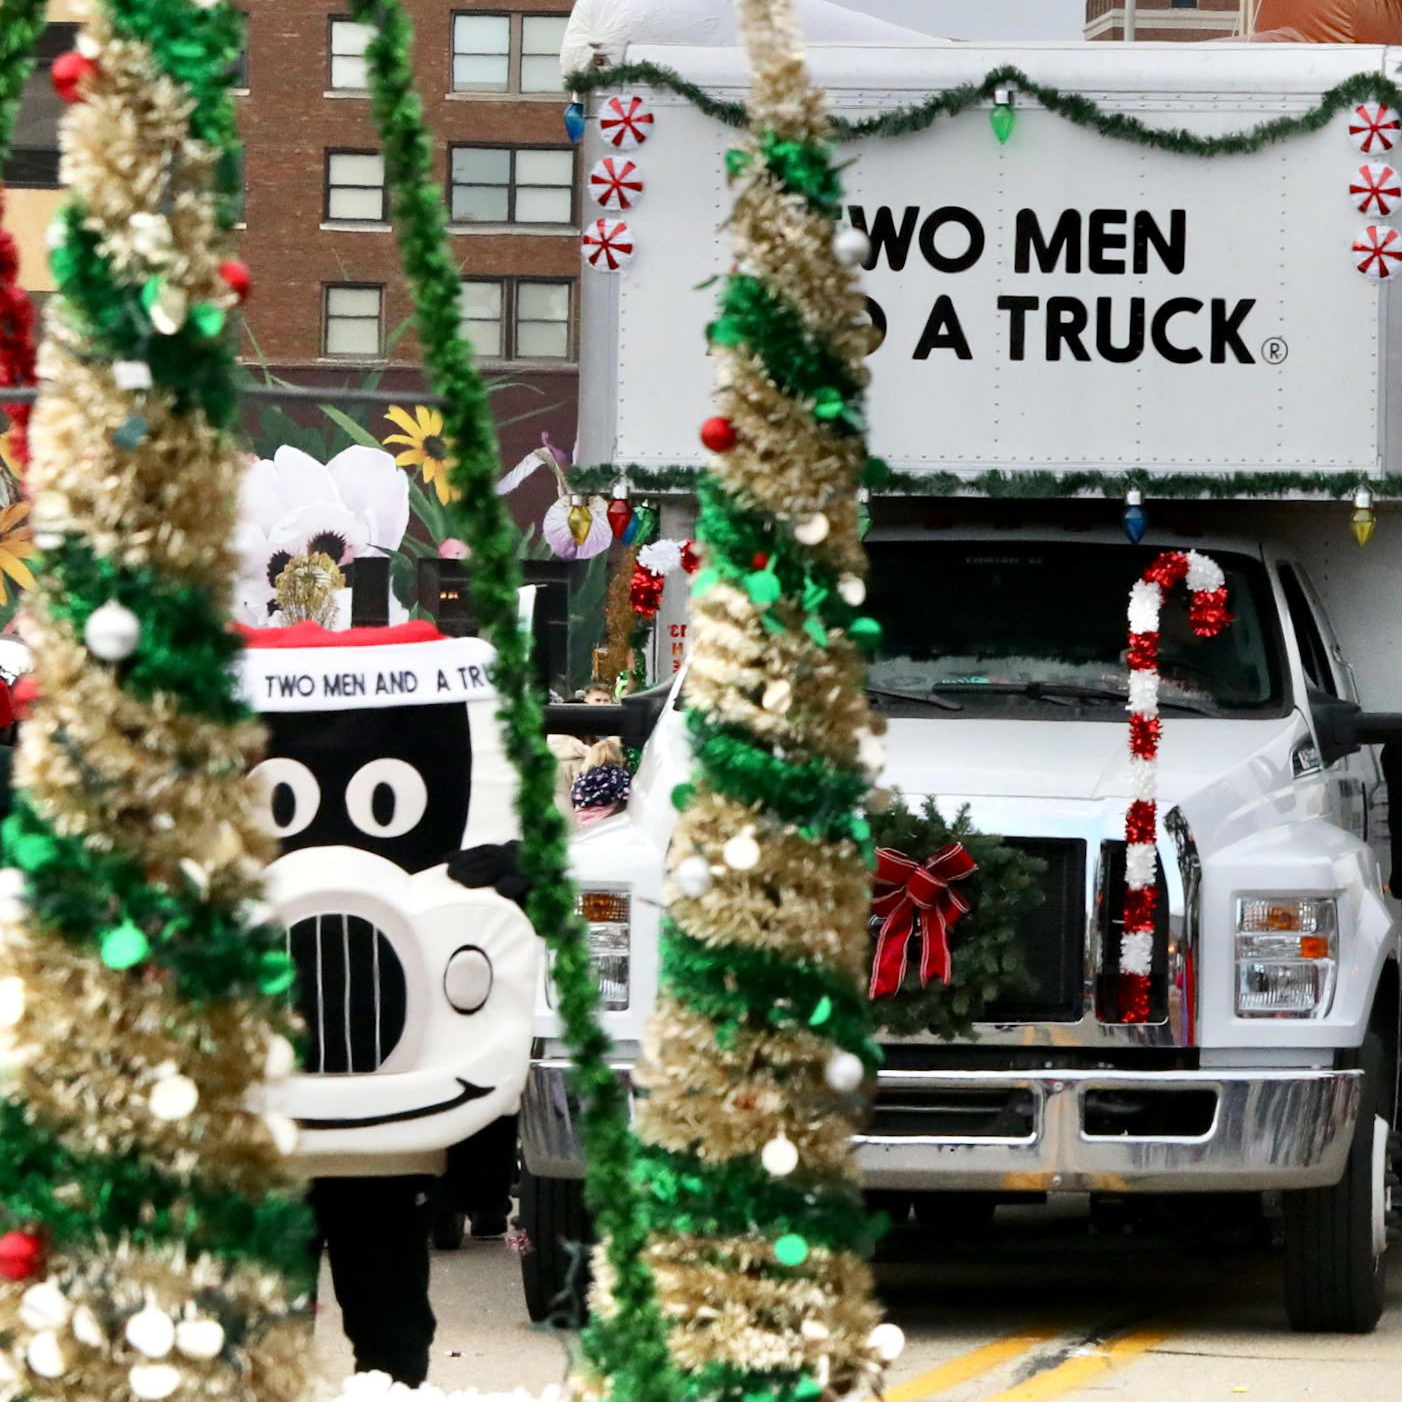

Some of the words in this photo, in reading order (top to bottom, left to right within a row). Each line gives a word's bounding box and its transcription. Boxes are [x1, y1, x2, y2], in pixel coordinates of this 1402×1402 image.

[840, 206, 985, 273] WO
[1013, 207, 1186, 275] MEN
[912, 295, 973, 360] A
[265, 674, 315, 699] TWO
[323, 672, 366, 697] MEN
[375, 670, 418, 695] AND
[436, 669, 451, 693] A
